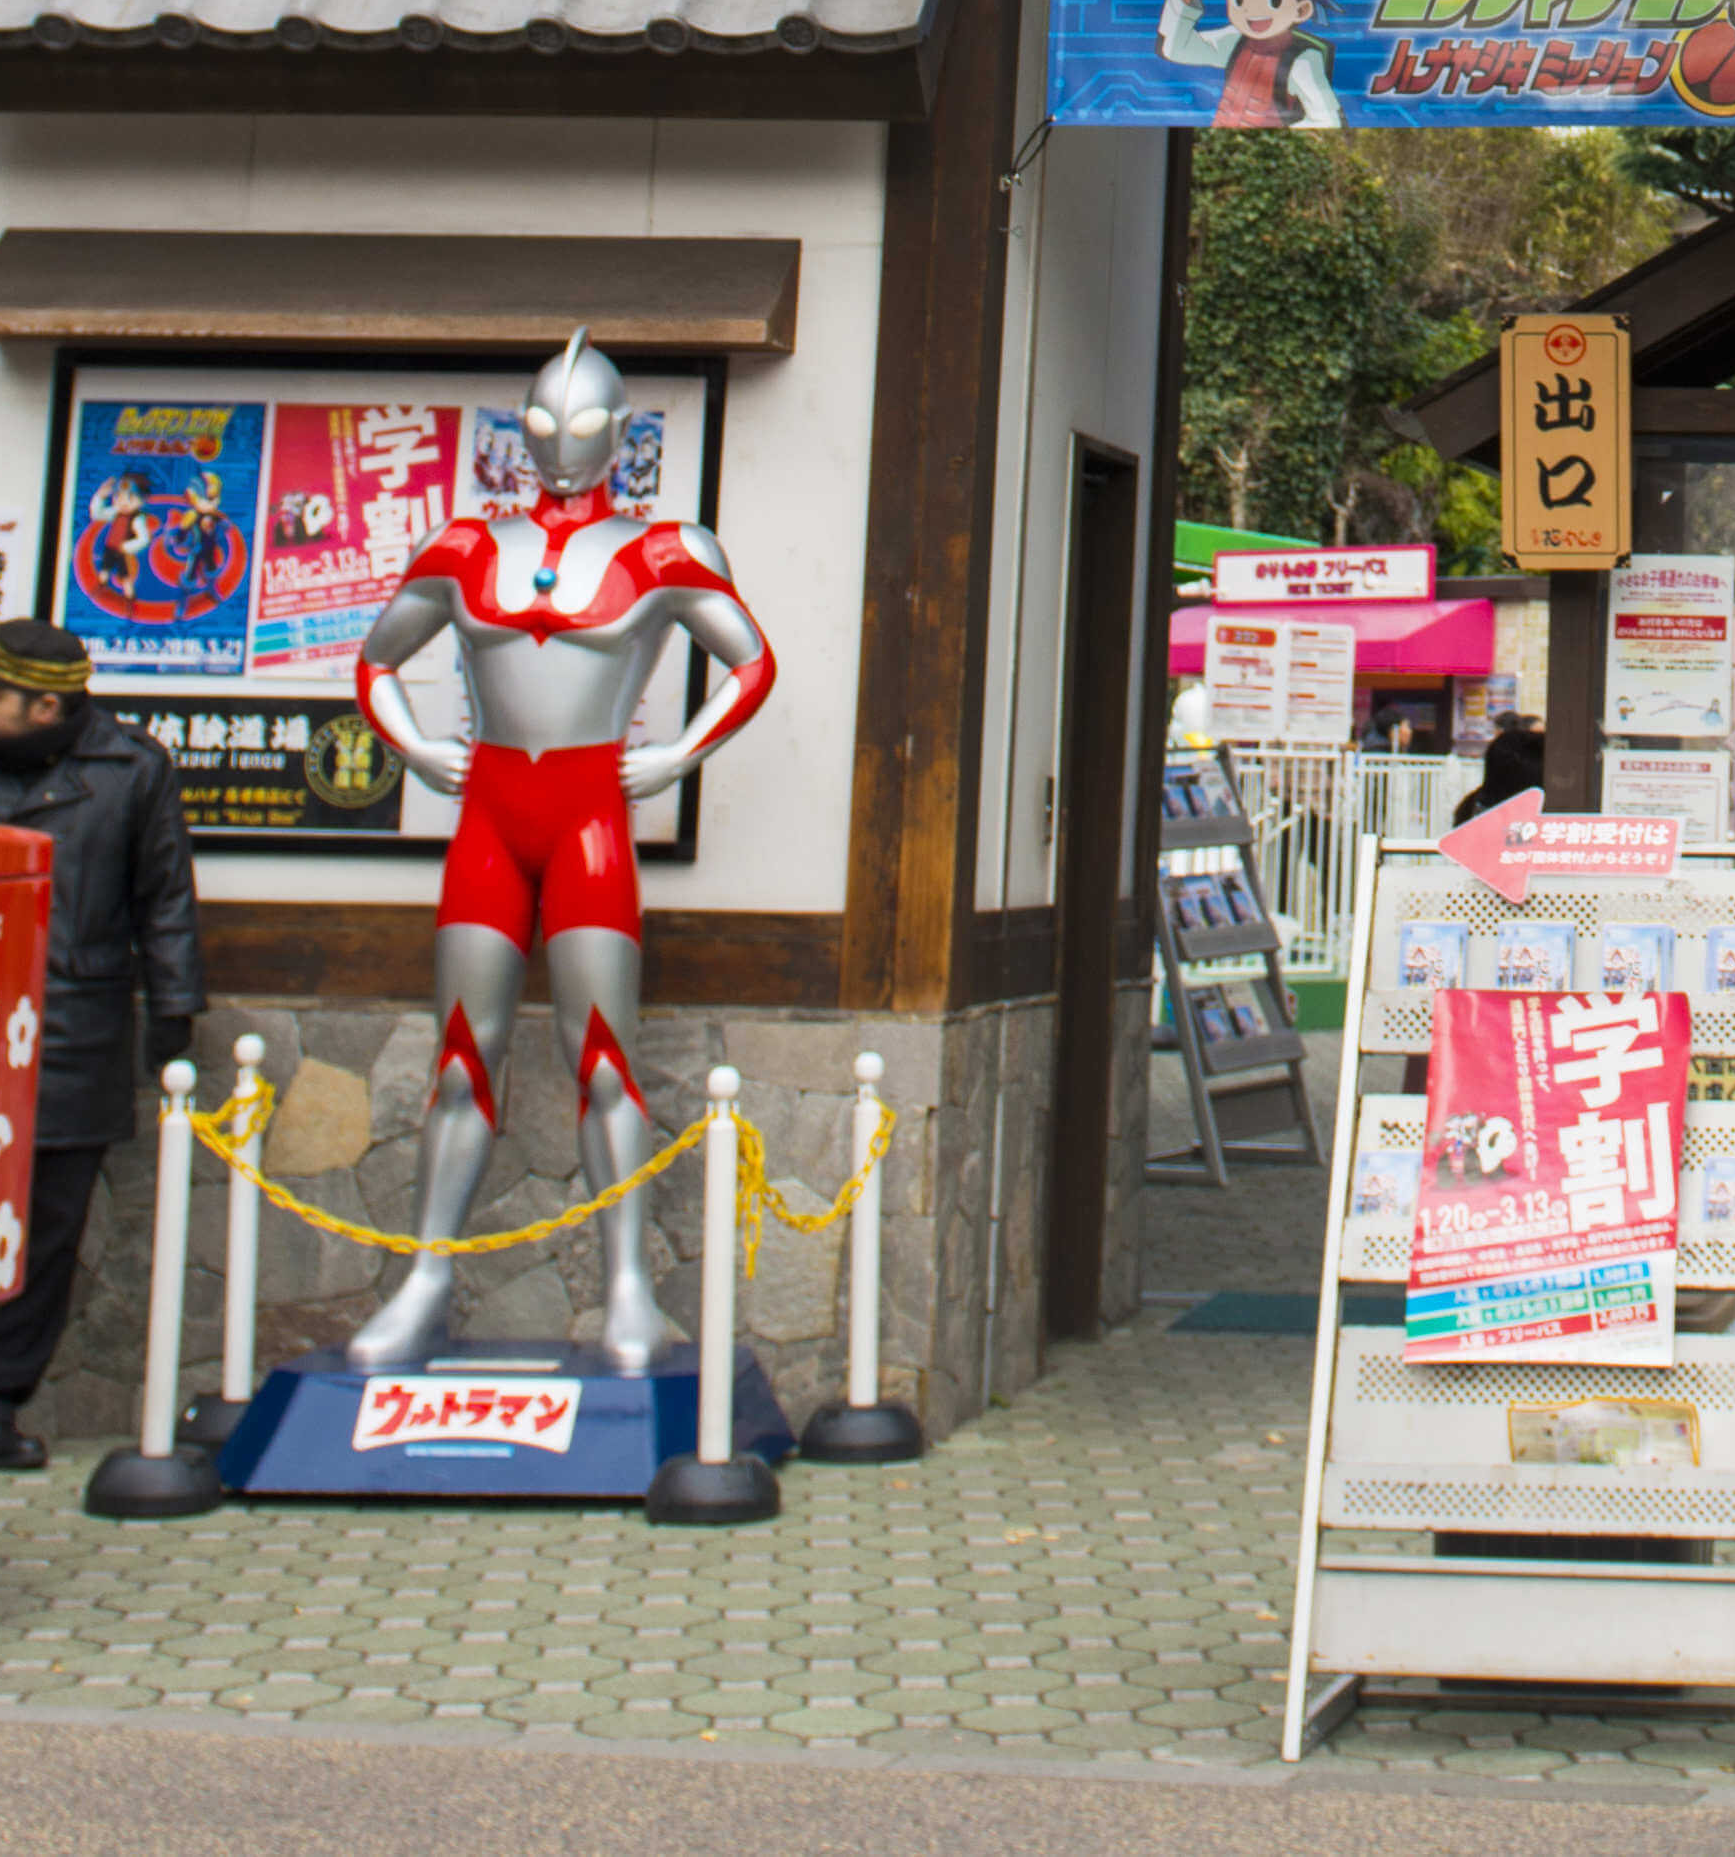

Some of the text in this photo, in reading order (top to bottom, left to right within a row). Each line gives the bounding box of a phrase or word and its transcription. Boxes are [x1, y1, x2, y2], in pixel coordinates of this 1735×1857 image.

[1533, 372, 1596, 510] 出口
[1540, 821, 1670, 846] 学割受付は
[1549, 992, 1678, 1234] 学割
[367, 1383, 570, 1436] ウルトラマン
